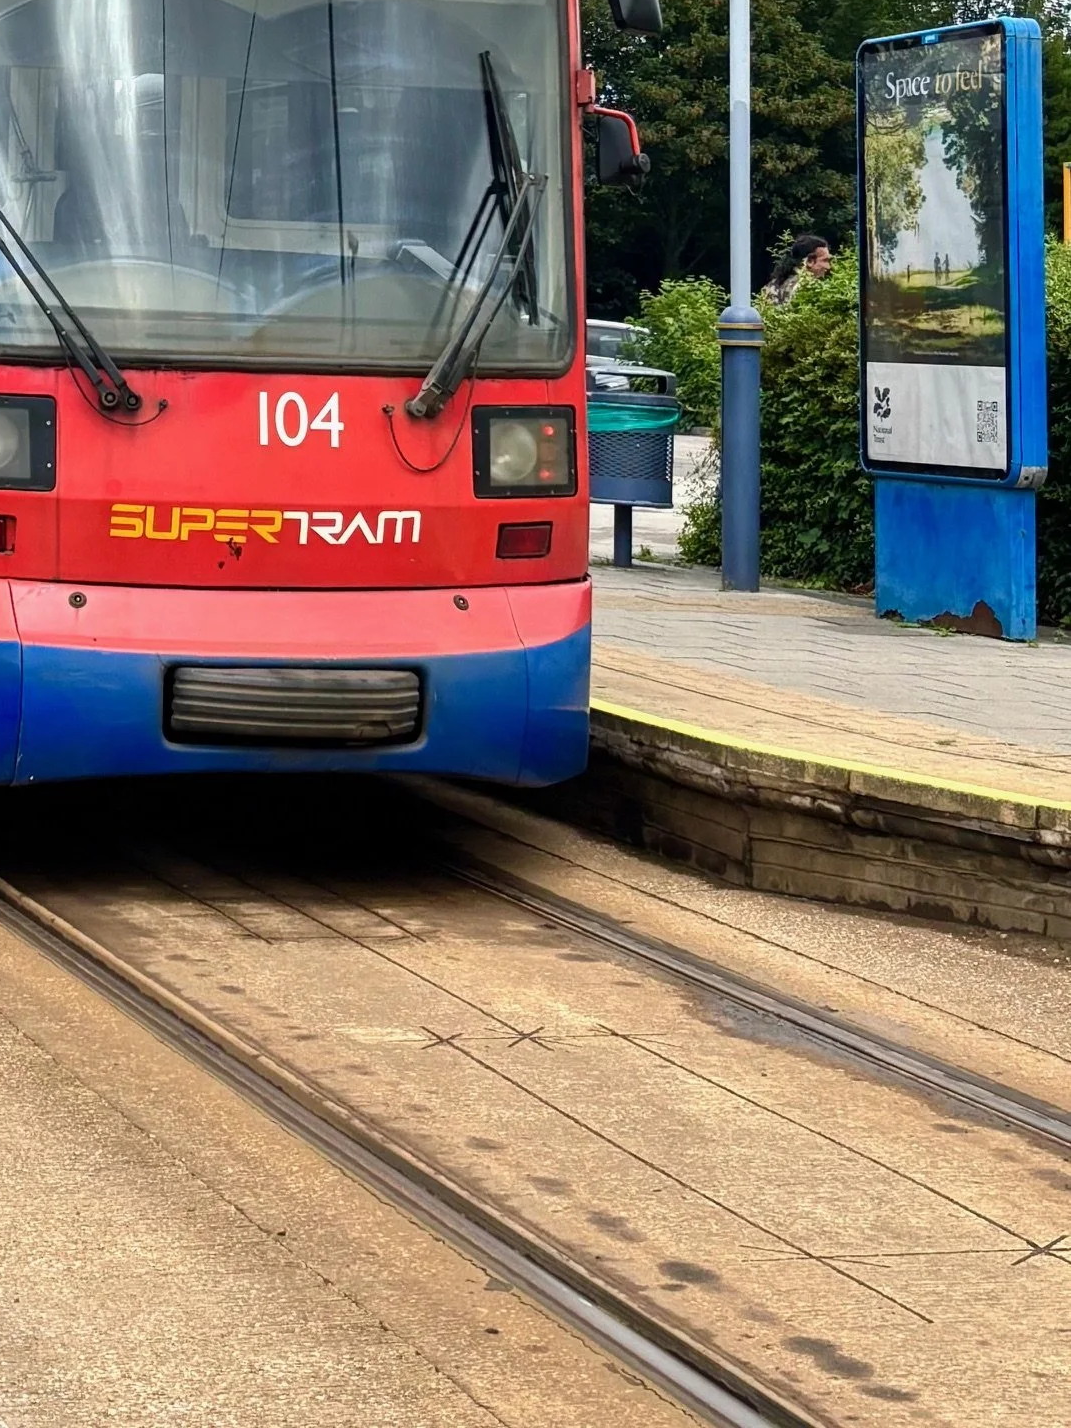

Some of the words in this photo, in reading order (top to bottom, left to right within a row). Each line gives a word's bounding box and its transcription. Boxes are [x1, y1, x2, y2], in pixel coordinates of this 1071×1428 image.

[885, 71, 930, 106] Space
[935, 73, 951, 94] to
[955, 60, 982, 91] feel
[259, 391, 345, 448] 104
[109, 503, 423, 545] SUPERTRAM
